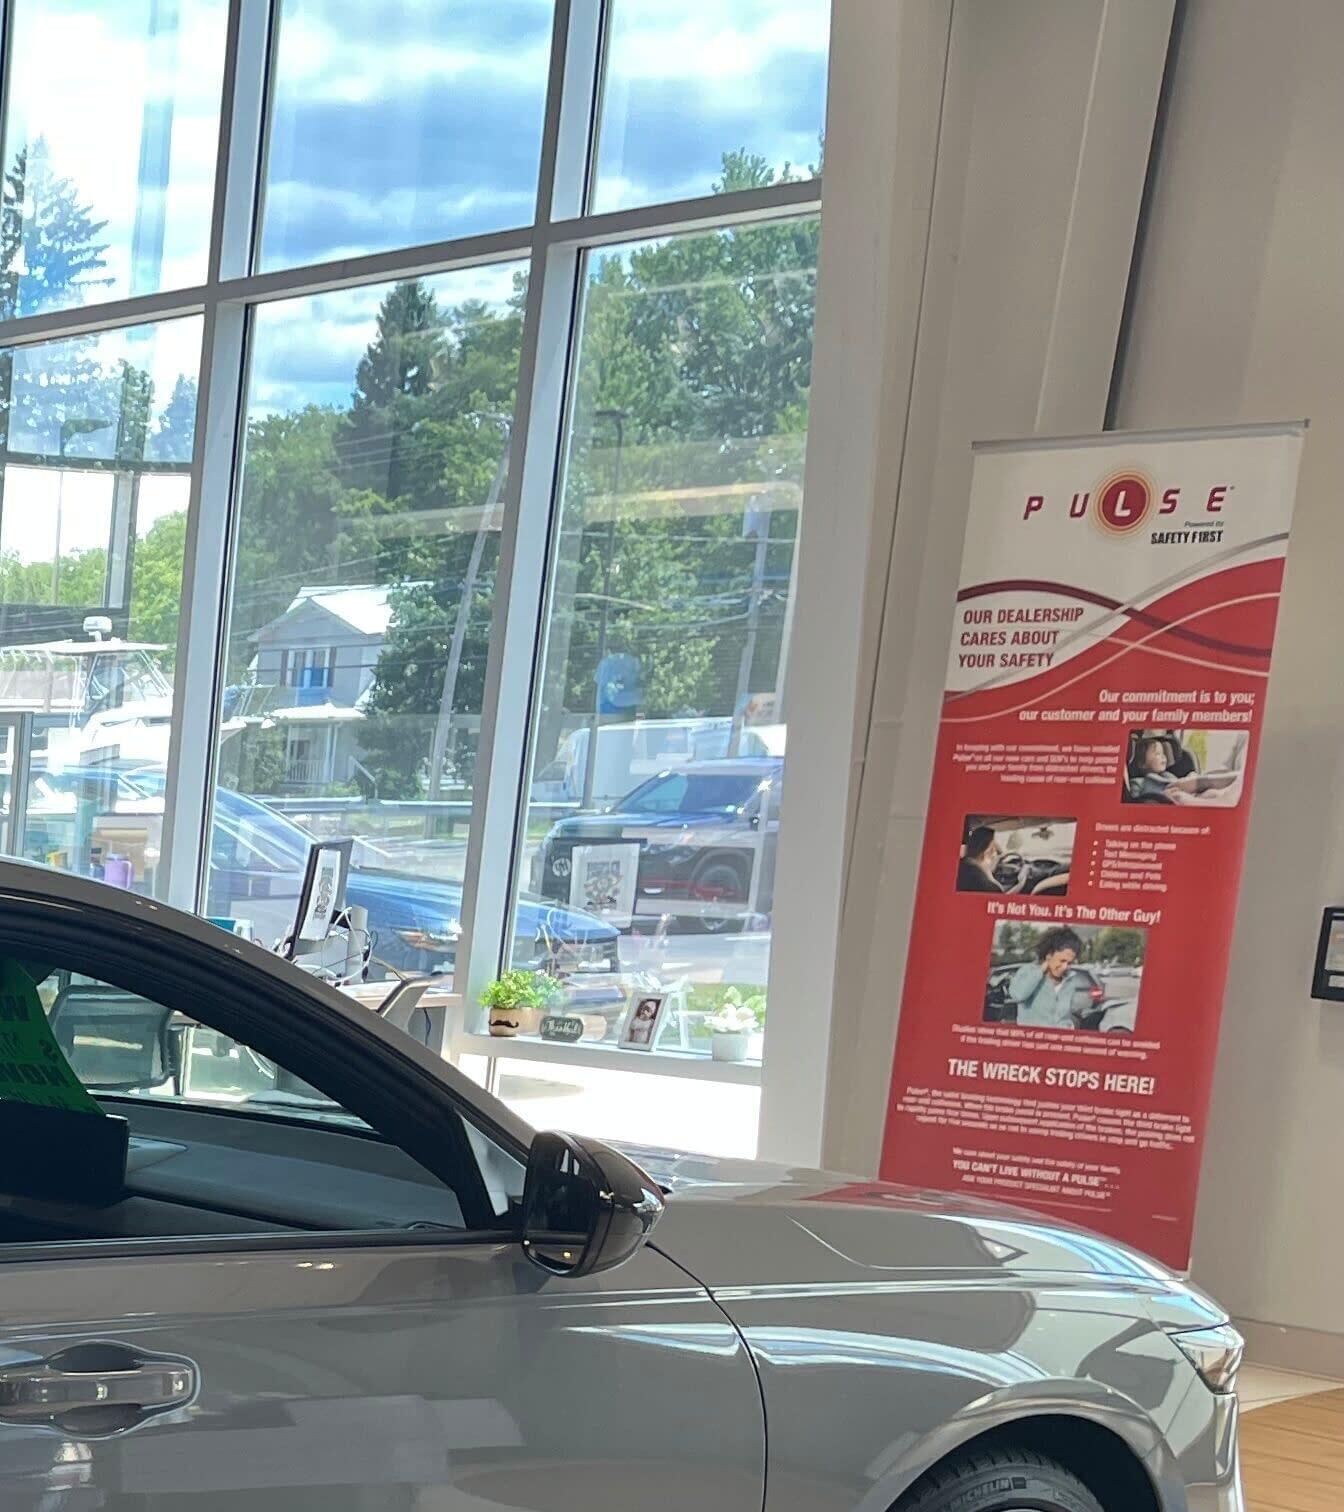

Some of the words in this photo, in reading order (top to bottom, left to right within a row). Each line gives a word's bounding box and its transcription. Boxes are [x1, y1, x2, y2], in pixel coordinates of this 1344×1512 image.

[1023, 486, 1228, 521] PULSE
[1151, 531, 1190, 544] SAFETY
[1192, 530, 1224, 543] FIRST
[963, 609, 993, 624] OUR
[997, 607, 1084, 623] DEALERSHIP
[960, 631, 1007, 646] CARES
[1010, 630, 1060, 645] ABOUT
[958, 653, 995, 667] YOUR
[1000, 652, 1054, 667] SAFETY
[1099, 689, 1119, 703] Our
[1122, 689, 1197, 703] commitment
[1200, 689, 1211, 703] is
[1214, 690, 1226, 703] to
[1019, 710, 1038, 721] our
[1041, 709, 1096, 721] customer
[1098, 708, 1120, 720] and
[1122, 711, 1148, 724] your
[1152, 709, 1189, 724] family
[987, 901, 1005, 914] It's
[1007, 902, 1026, 916] Not
[1029, 903, 1052, 917] You.
[1055, 904, 1073, 918] It's
[1077, 906, 1096, 919] The
[1099, 907, 1130, 921] Other
[1133, 909, 1161, 925] Guy!
[948, 1058, 979, 1077] THE
[982, 1061, 1042, 1084] WRECK
[1045, 1067, 1100, 1090] STOPS
[1104, 1074, 1155, 1095] HERE!
